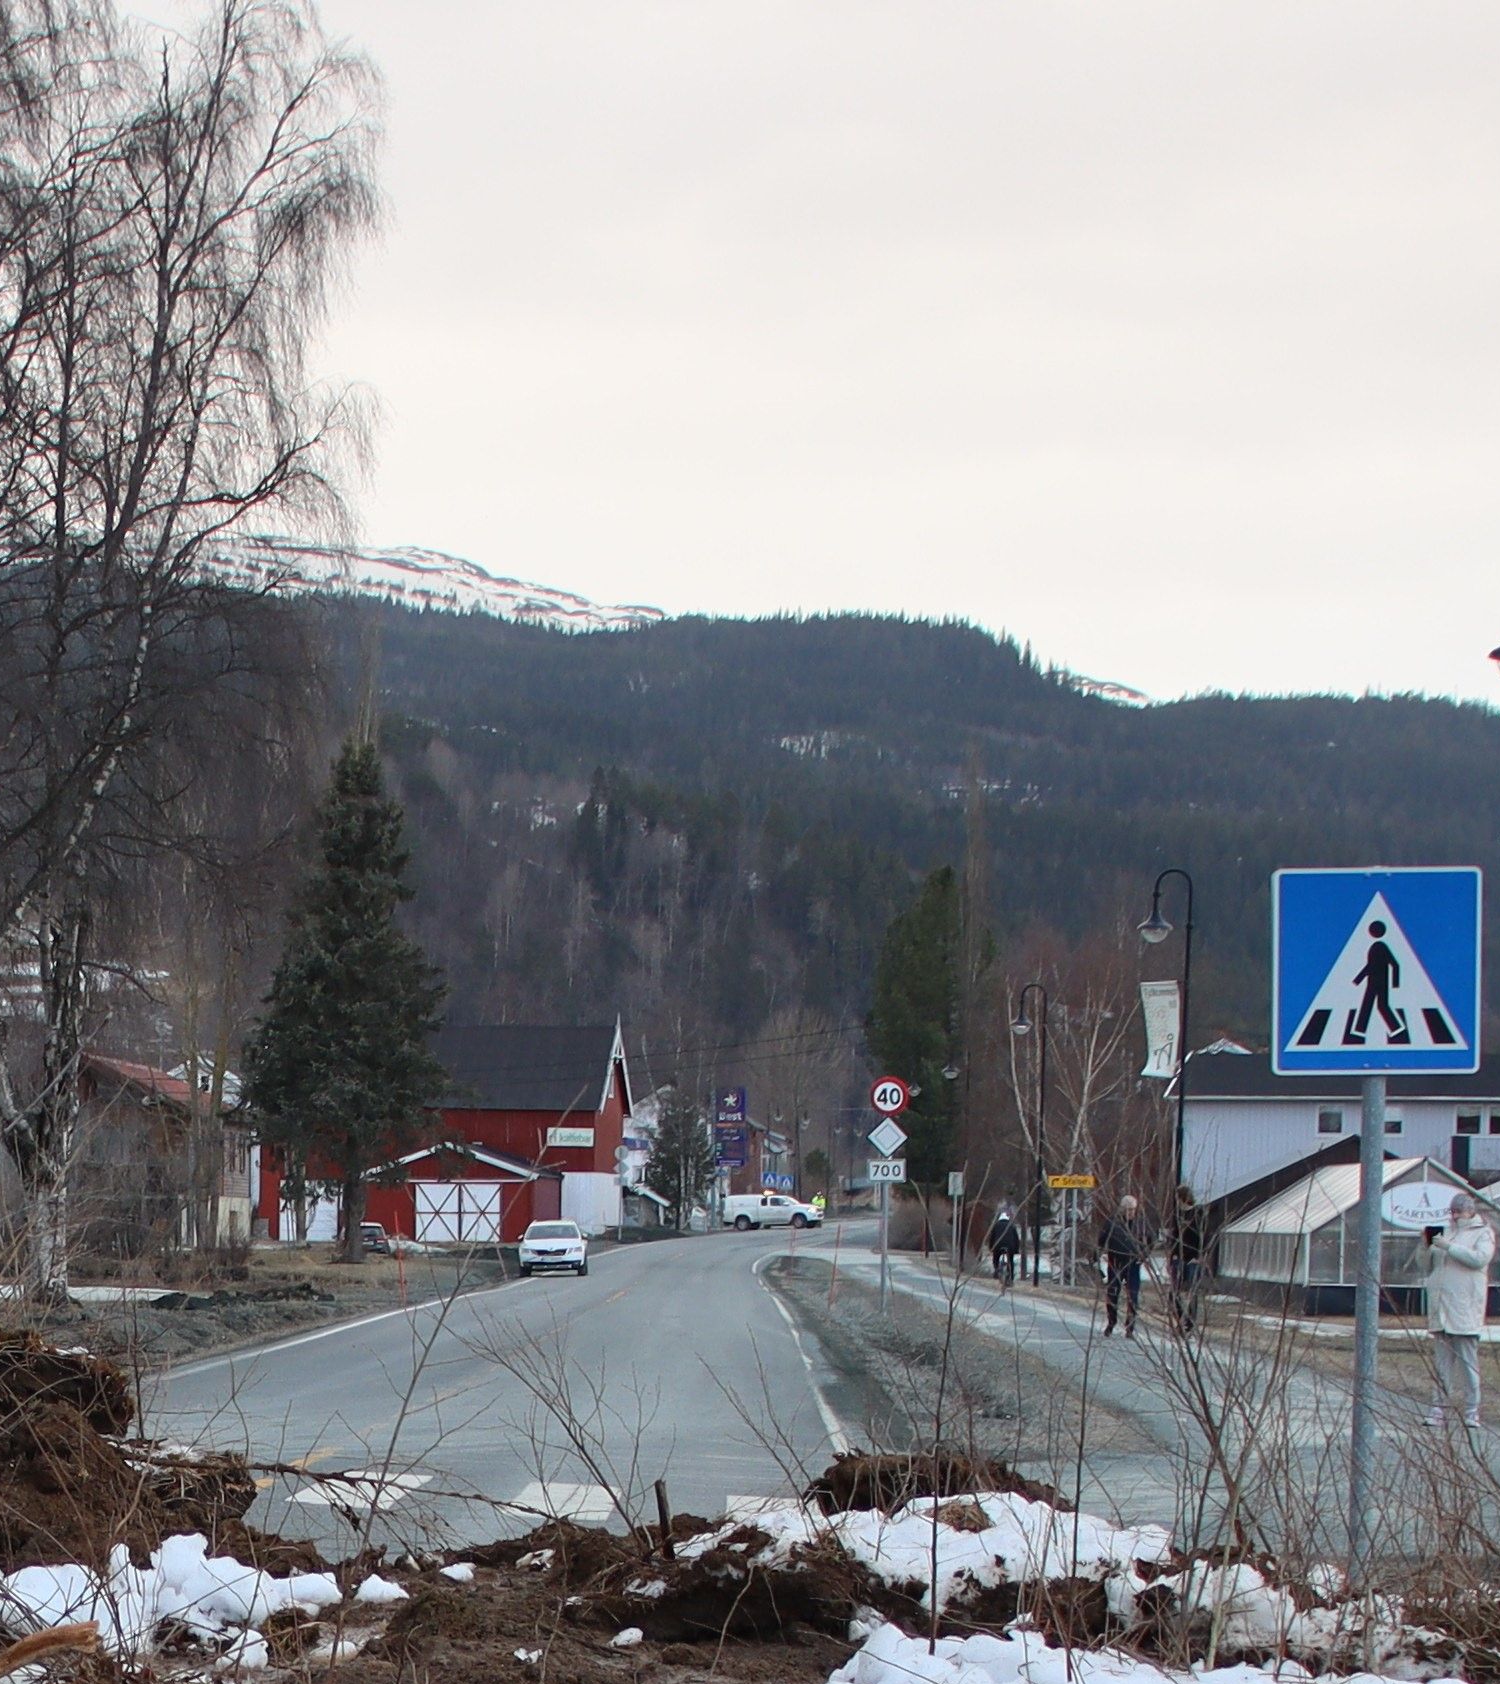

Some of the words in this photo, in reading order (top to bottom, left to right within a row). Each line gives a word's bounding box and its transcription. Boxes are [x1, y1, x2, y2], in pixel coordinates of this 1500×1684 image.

[877, 1088, 901, 1105] 40
[872, 1165, 901, 1177] 700
[1392, 1205, 1452, 1219] GARTNER
